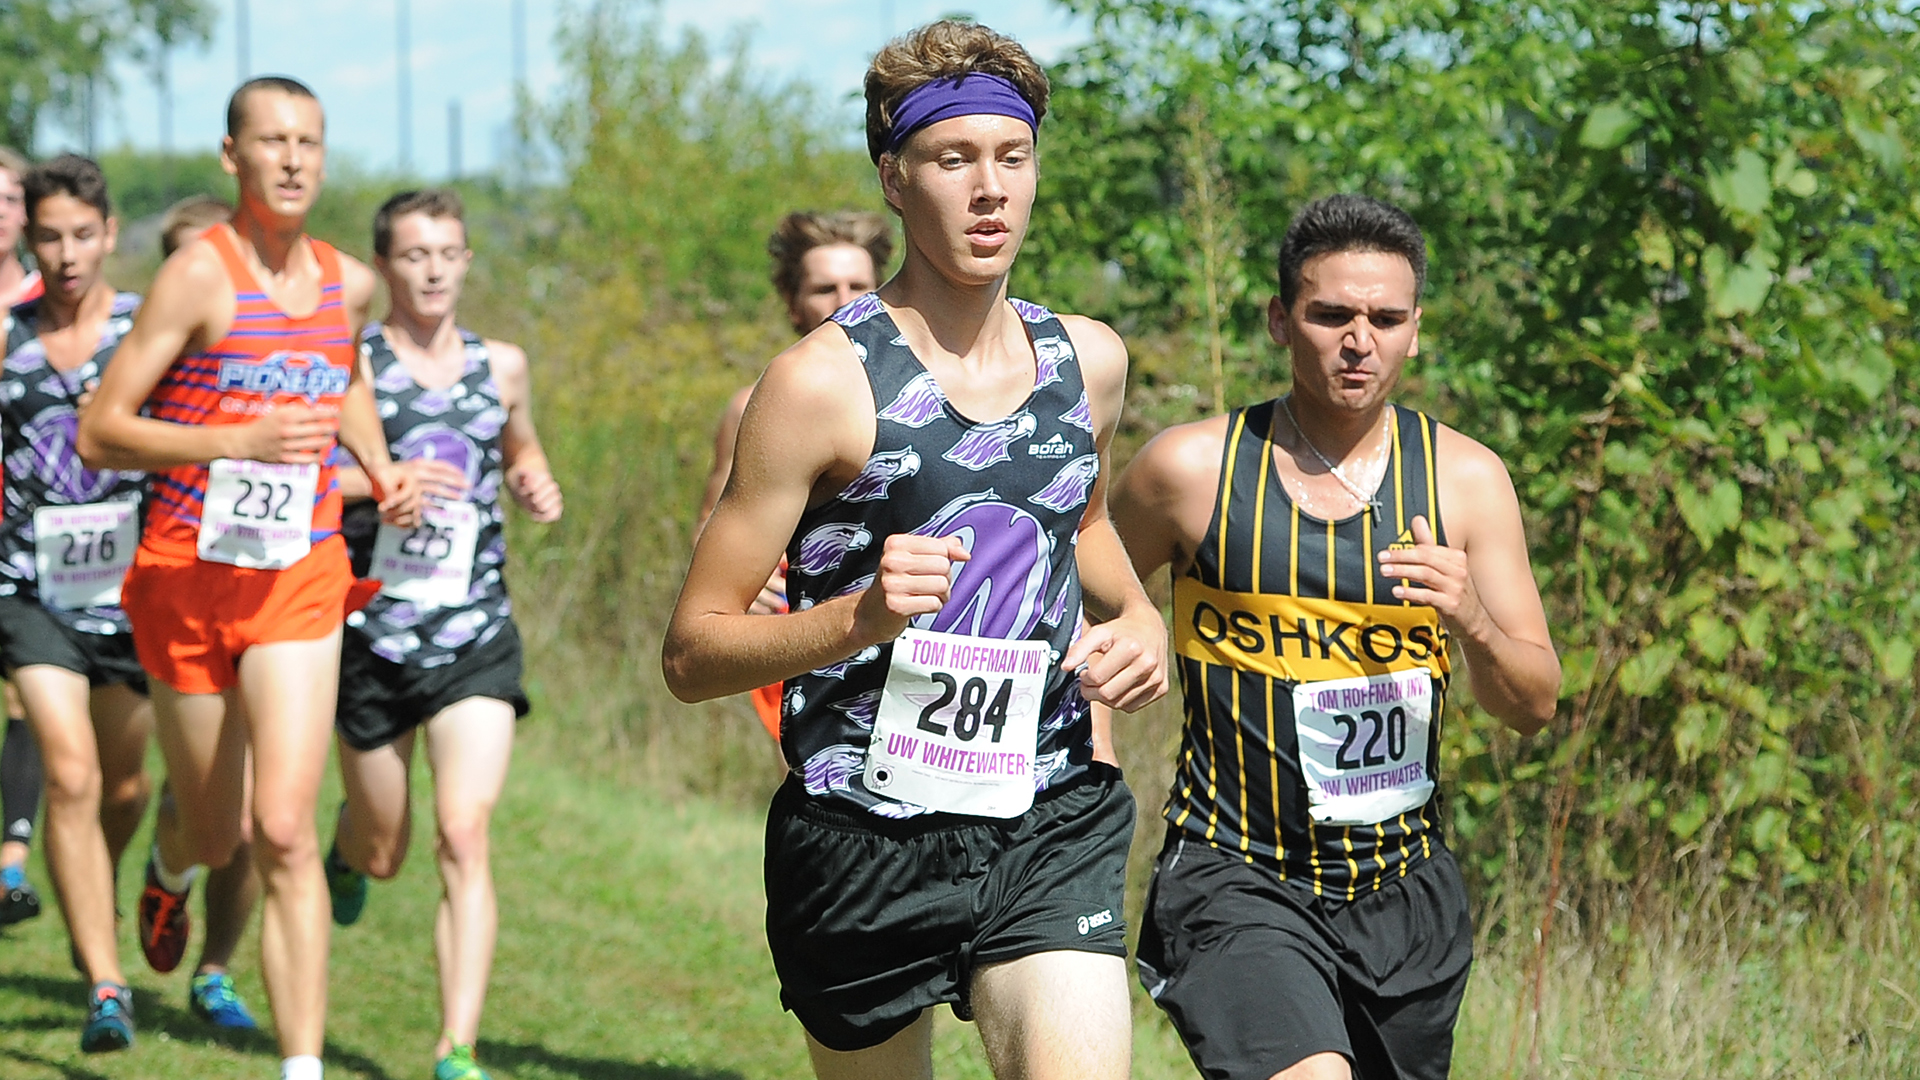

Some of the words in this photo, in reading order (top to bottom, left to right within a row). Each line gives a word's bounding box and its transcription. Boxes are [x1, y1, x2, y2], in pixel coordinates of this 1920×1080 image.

[232, 479, 292, 522] 232
[60, 530, 115, 566] 276
[911, 639, 946, 667] TOM
[949, 644, 1018, 674] HOFFMAN
[1019, 649, 1042, 675] INV.
[916, 672, 1014, 743] 284
[1309, 689, 1340, 713] TOM
[1342, 682, 1403, 709] HOFFMAN
[887, 732, 919, 760] UW
[922, 741, 1026, 776] WHITEWATER
[1333, 706, 1406, 771] 220
[1319, 779, 1341, 799] UW
[1345, 761, 1422, 797] WHITEWATER
